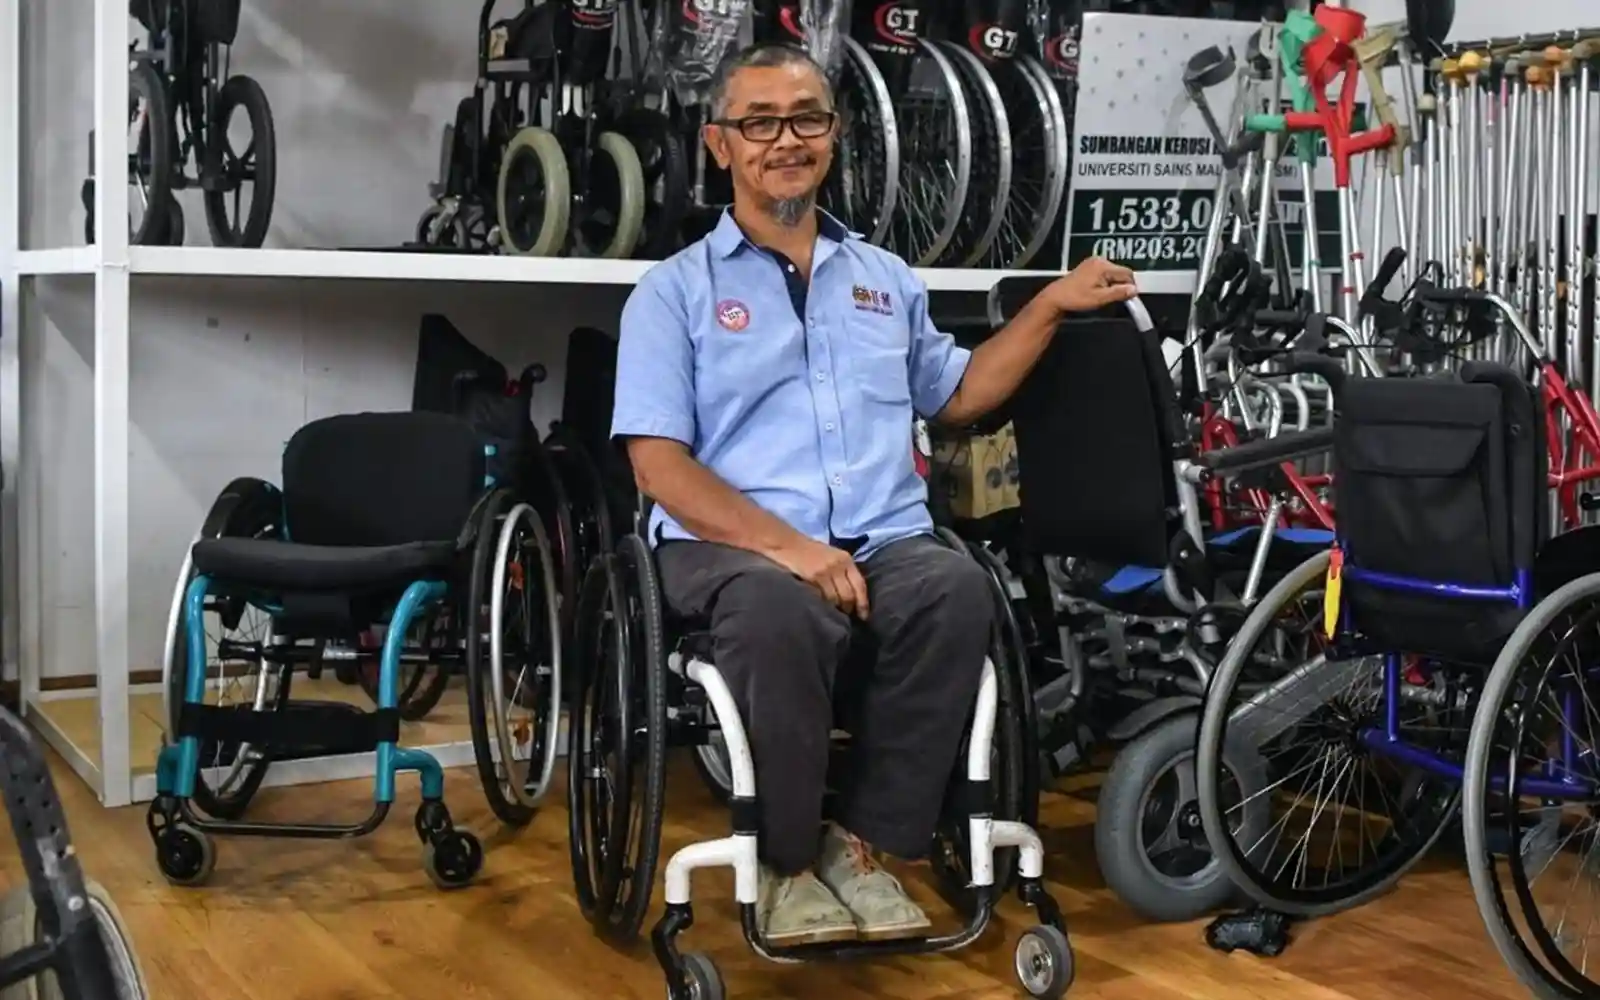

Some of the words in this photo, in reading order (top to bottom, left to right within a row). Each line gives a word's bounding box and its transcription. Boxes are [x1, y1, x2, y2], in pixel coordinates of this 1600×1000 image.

[886, 7, 919, 30] GT
[984, 27, 1018, 51] GT
[1060, 38, 1078, 58] G
[1080, 135, 1162, 154] SUMBANGAN
[1164, 137, 1210, 155] KERUSI
[1078, 162, 1150, 176] UNIVERSITI
[1154, 163, 1192, 176] SAINS
[1196, 164, 1222, 177] MAL
[1089, 197, 1213, 233] 1,533,0
